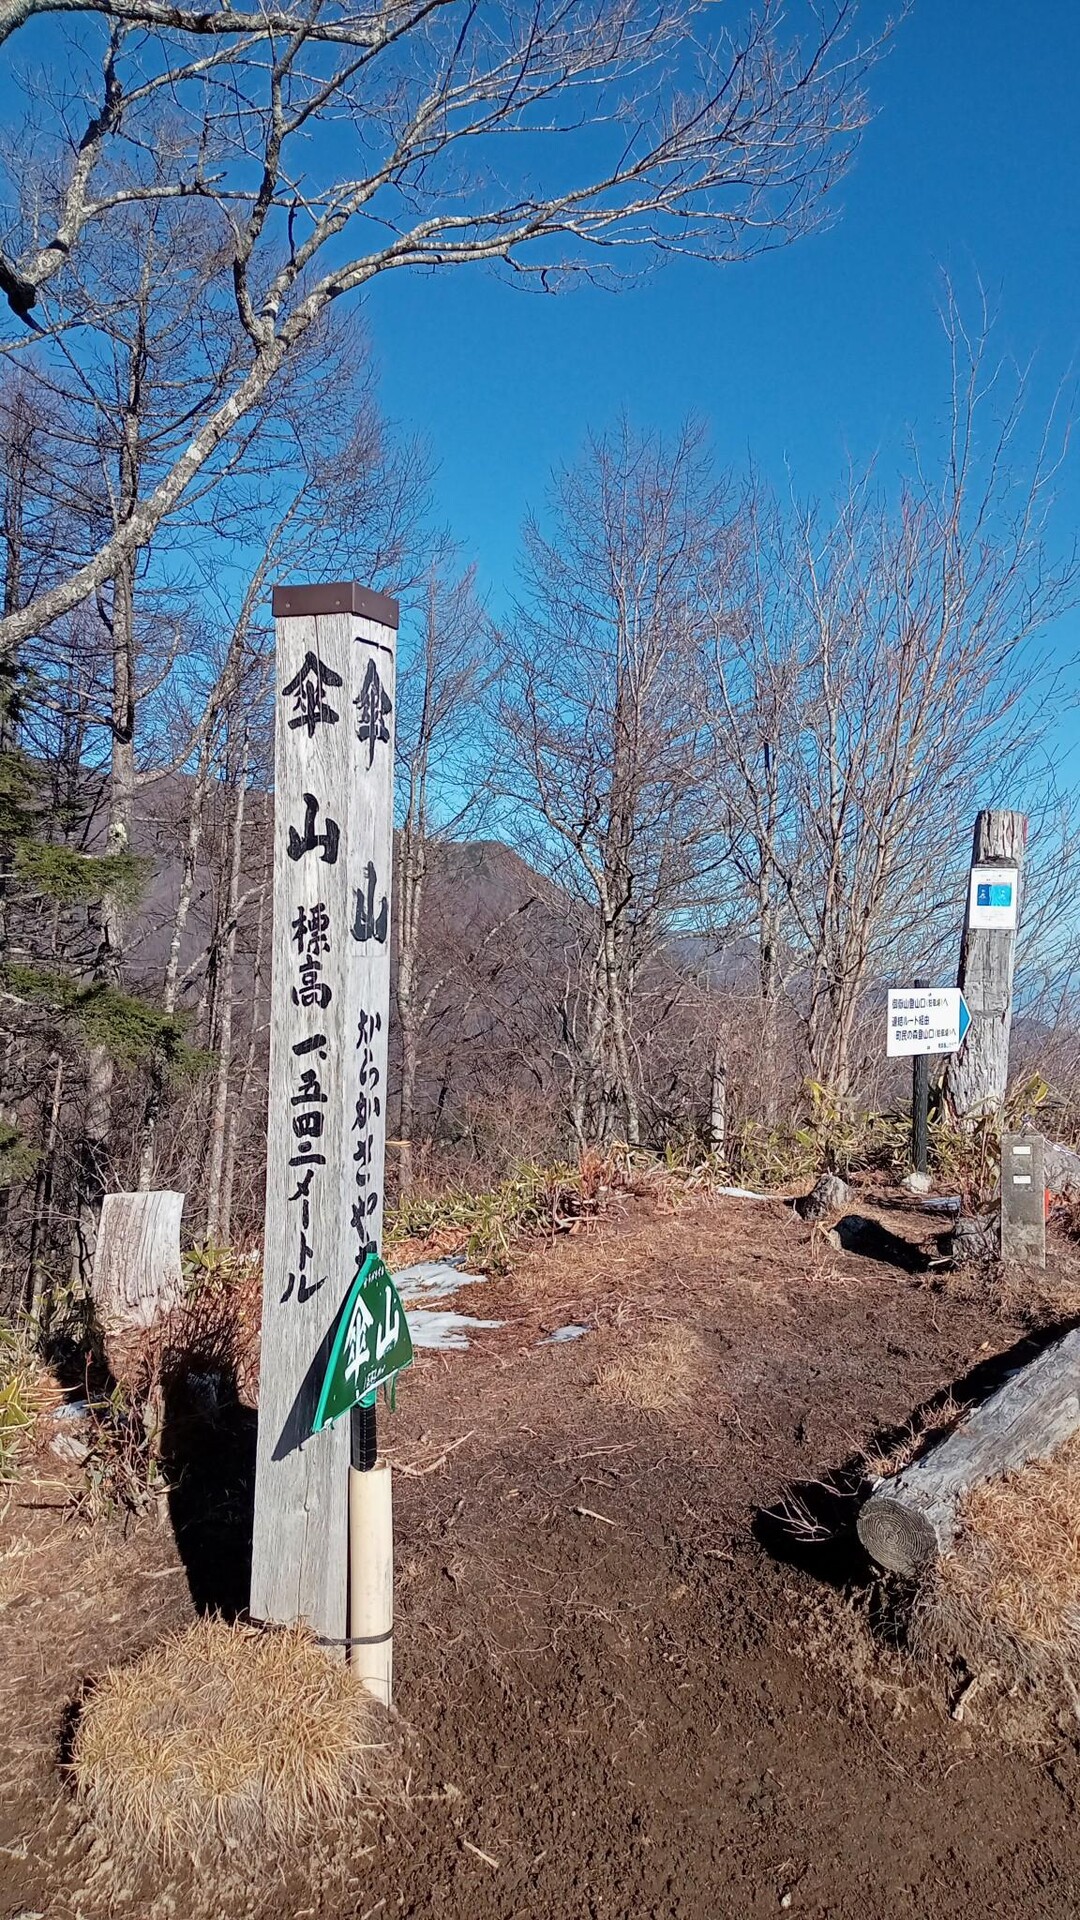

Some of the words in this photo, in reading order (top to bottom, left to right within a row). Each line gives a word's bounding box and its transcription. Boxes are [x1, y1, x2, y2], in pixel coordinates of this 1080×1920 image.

[282, 651, 342, 864] 傘山
[351, 658, 392, 943] 傘山
[343, 1285, 400, 1386] 傘山
